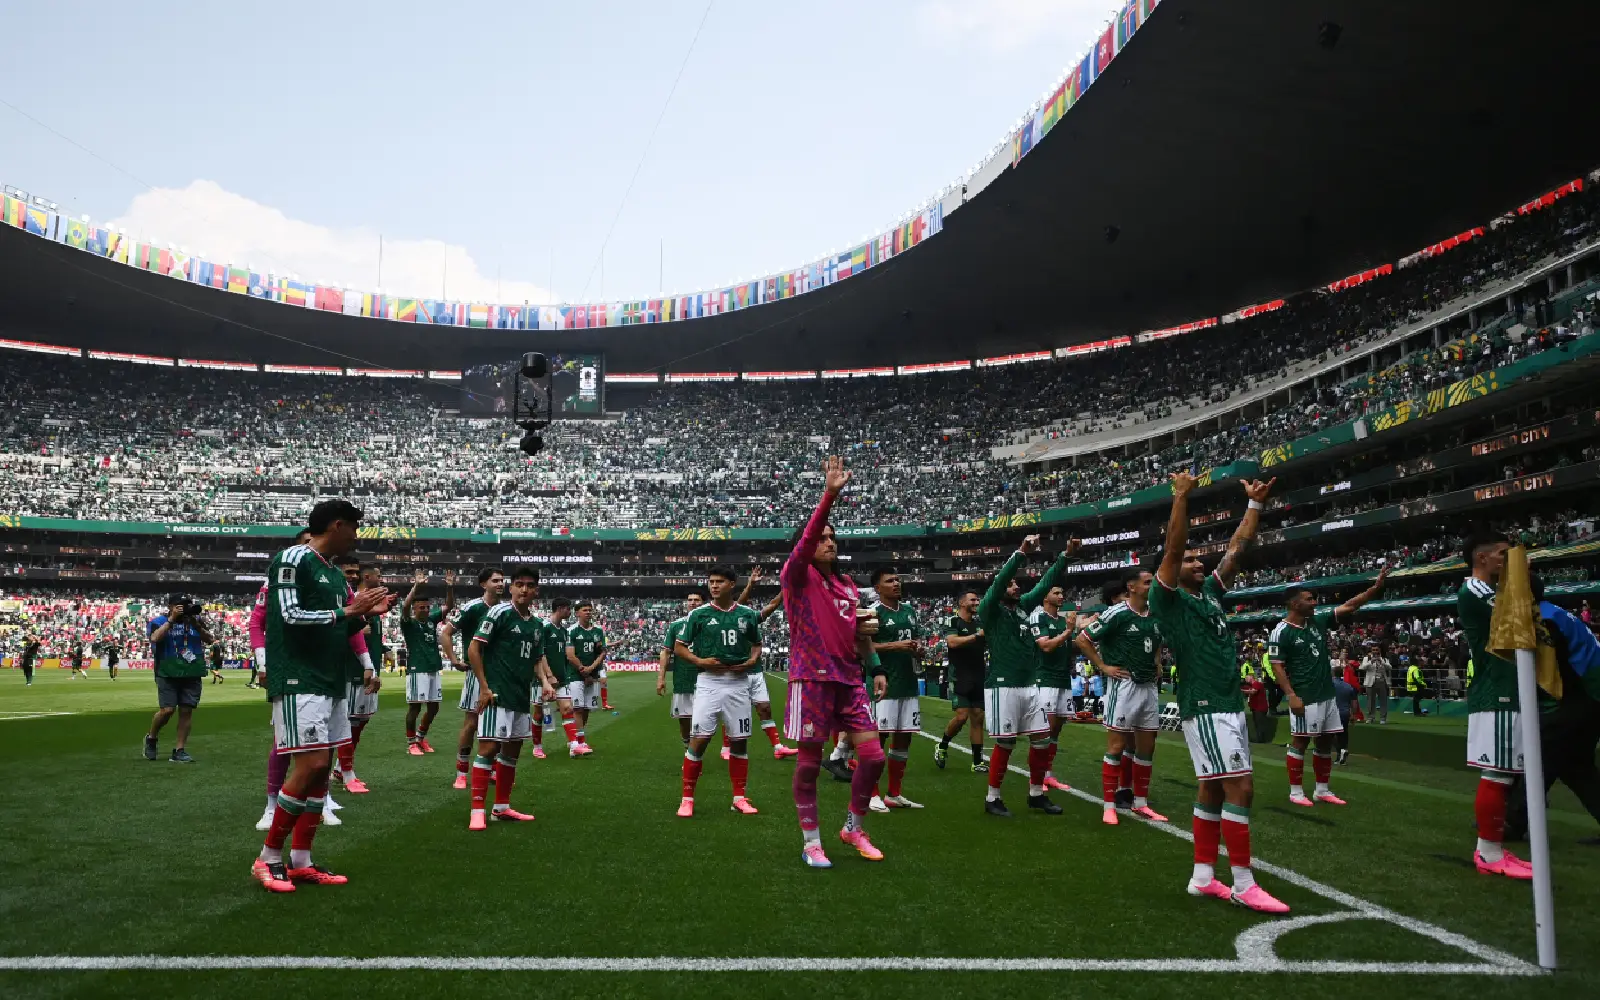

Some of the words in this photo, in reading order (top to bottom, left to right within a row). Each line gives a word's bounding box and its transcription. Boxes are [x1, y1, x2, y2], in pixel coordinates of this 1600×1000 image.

[1521, 424, 1550, 444] CITY
[1523, 472, 1554, 492] CITY
[1105, 533, 1119, 543] CUP
[502, 555, 520, 563] FIFA
[520, 555, 549, 563] WORLD
[549, 555, 565, 563] CUP
[565, 555, 593, 563] 2026
[1067, 564, 1082, 574] FIFA
[1082, 562, 1106, 573] WORLD
[1106, 561, 1119, 570] CUP
[721, 629, 737, 646] 18
[520, 640, 531, 659] 19
[583, 642, 594, 653] 20
[738, 718, 750, 733] 18
